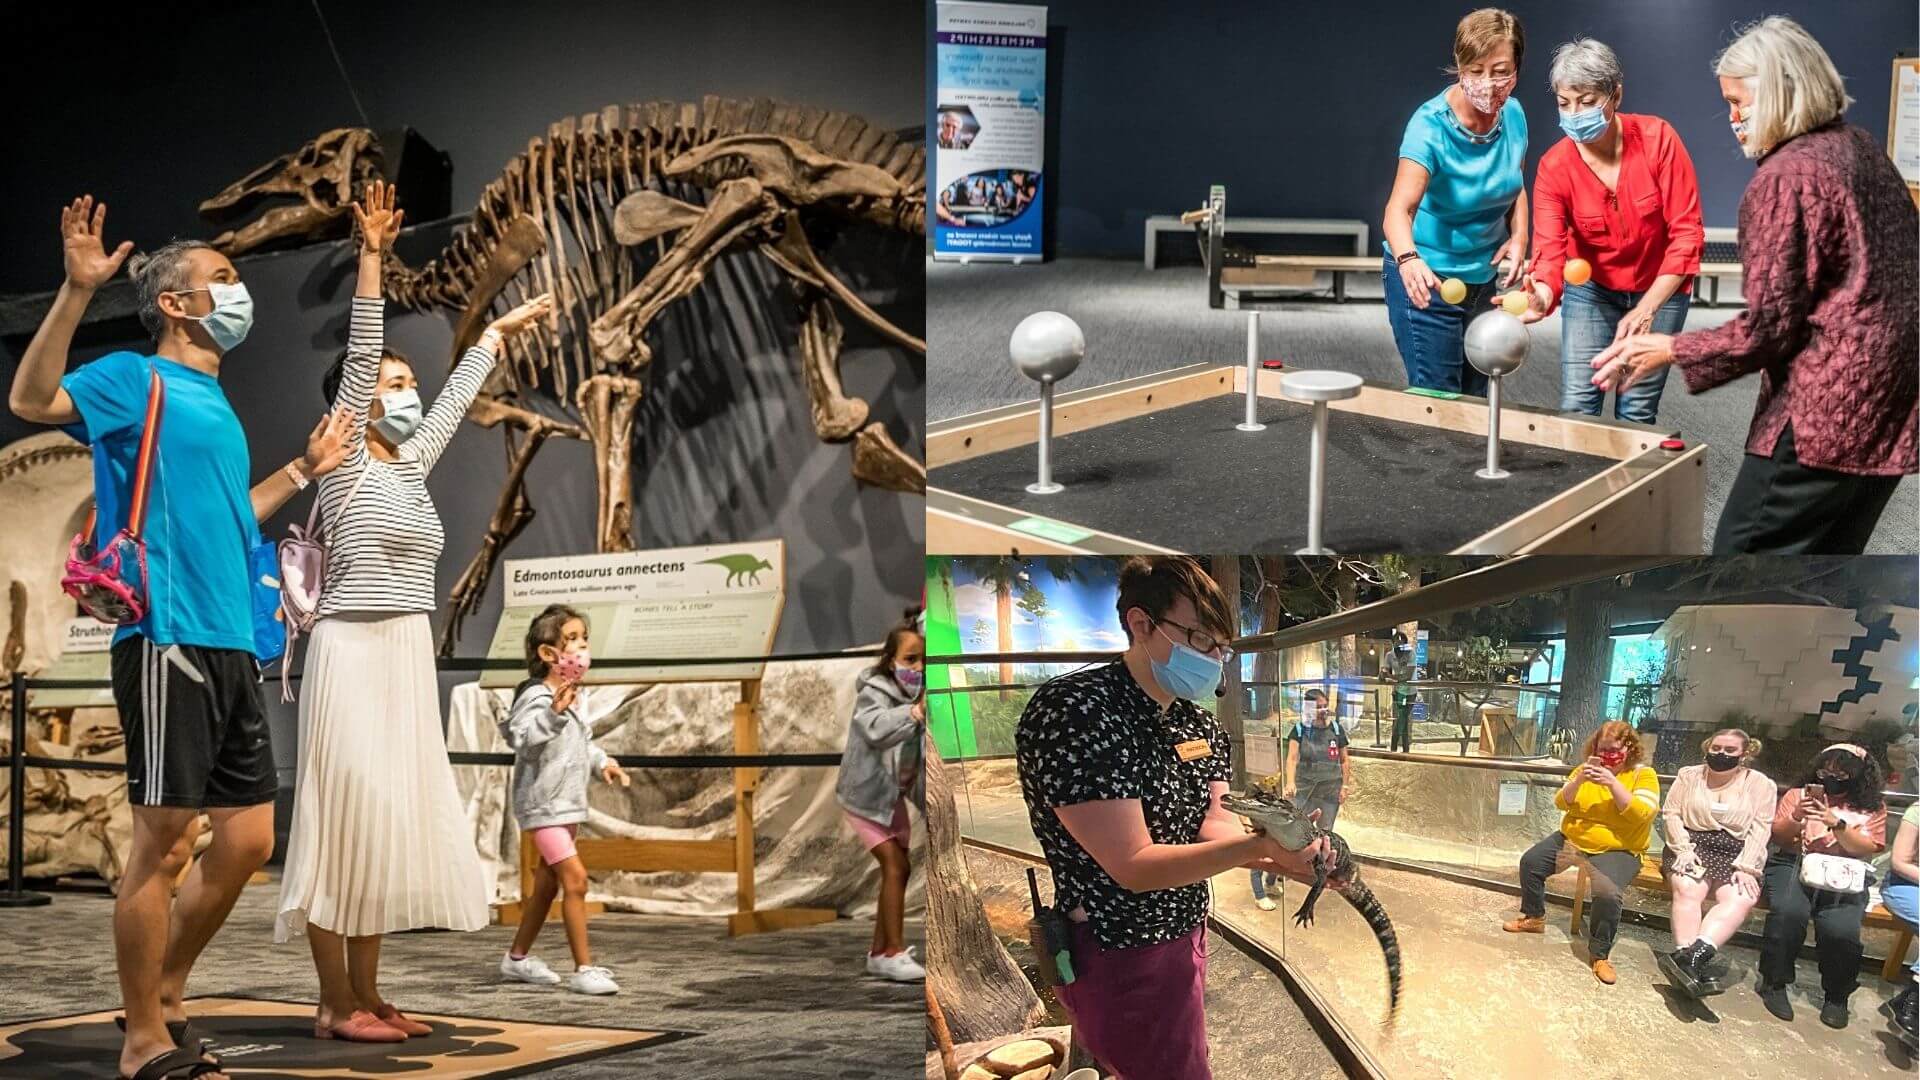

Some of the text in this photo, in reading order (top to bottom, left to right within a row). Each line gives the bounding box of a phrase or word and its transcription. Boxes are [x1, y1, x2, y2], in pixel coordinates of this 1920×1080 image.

[513, 561, 685, 583] Edmontosaurus annectens
[579, 584, 603, 592] million
[604, 584, 622, 592] years
[624, 584, 637, 592] ago
[688, 602, 713, 611] STORY
[69, 624, 114, 638] Struthio
